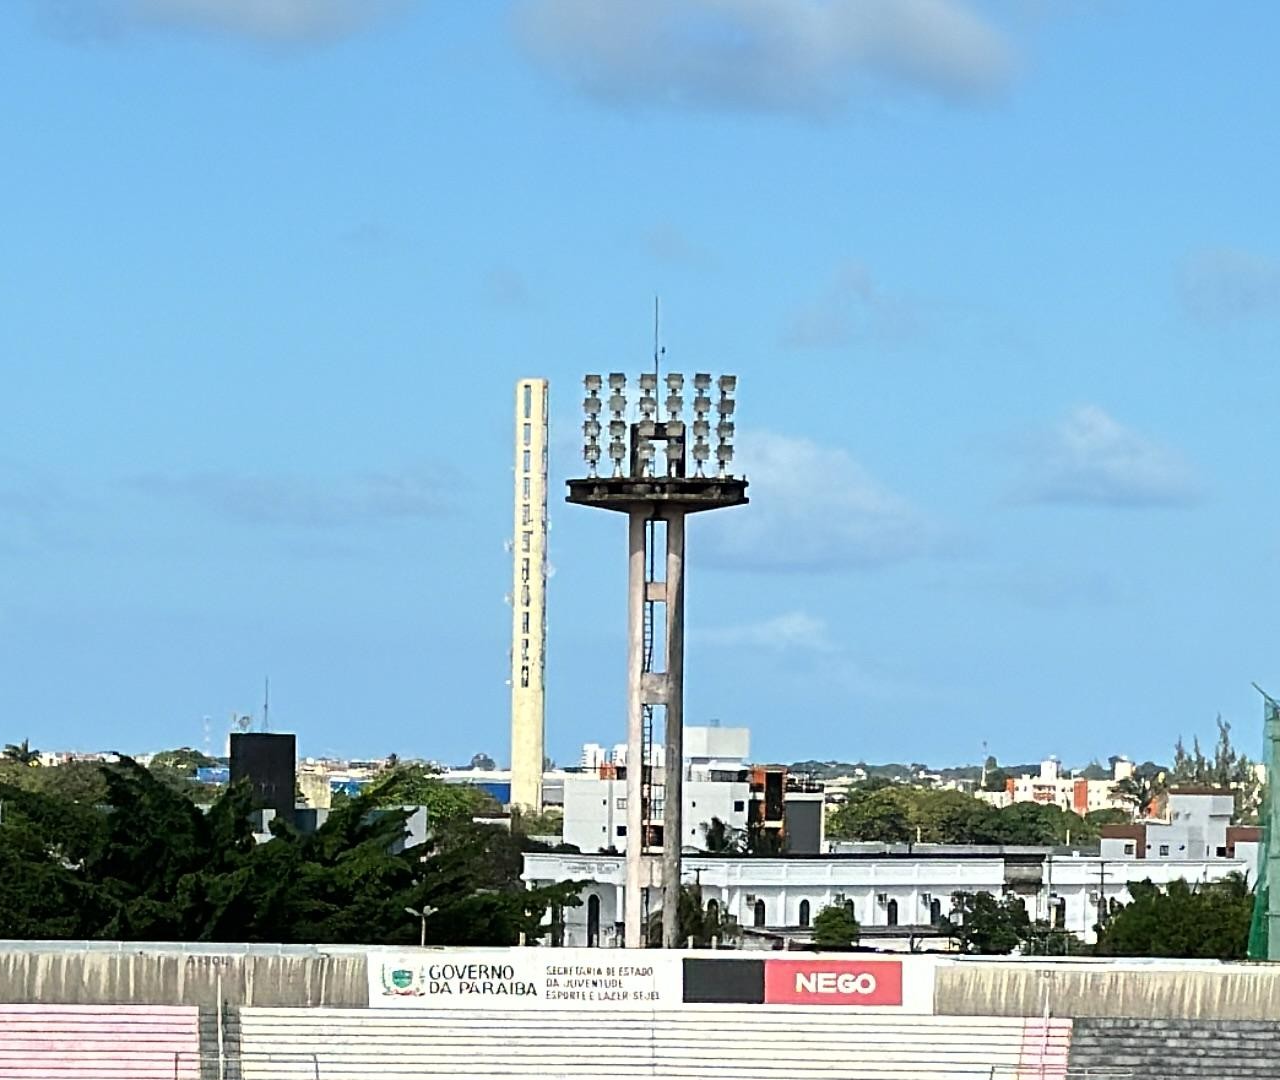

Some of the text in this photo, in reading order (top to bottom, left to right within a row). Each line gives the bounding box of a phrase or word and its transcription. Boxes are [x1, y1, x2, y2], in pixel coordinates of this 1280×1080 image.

[429, 964, 515, 980] GOVERNO
[618, 967, 654, 977] ESTADO
[429, 981, 452, 995] DA
[546, 978, 624, 989] DA JUVENTUDE
[795, 972, 877, 995] NEGO
[546, 990, 586, 1001] ESPORTE
